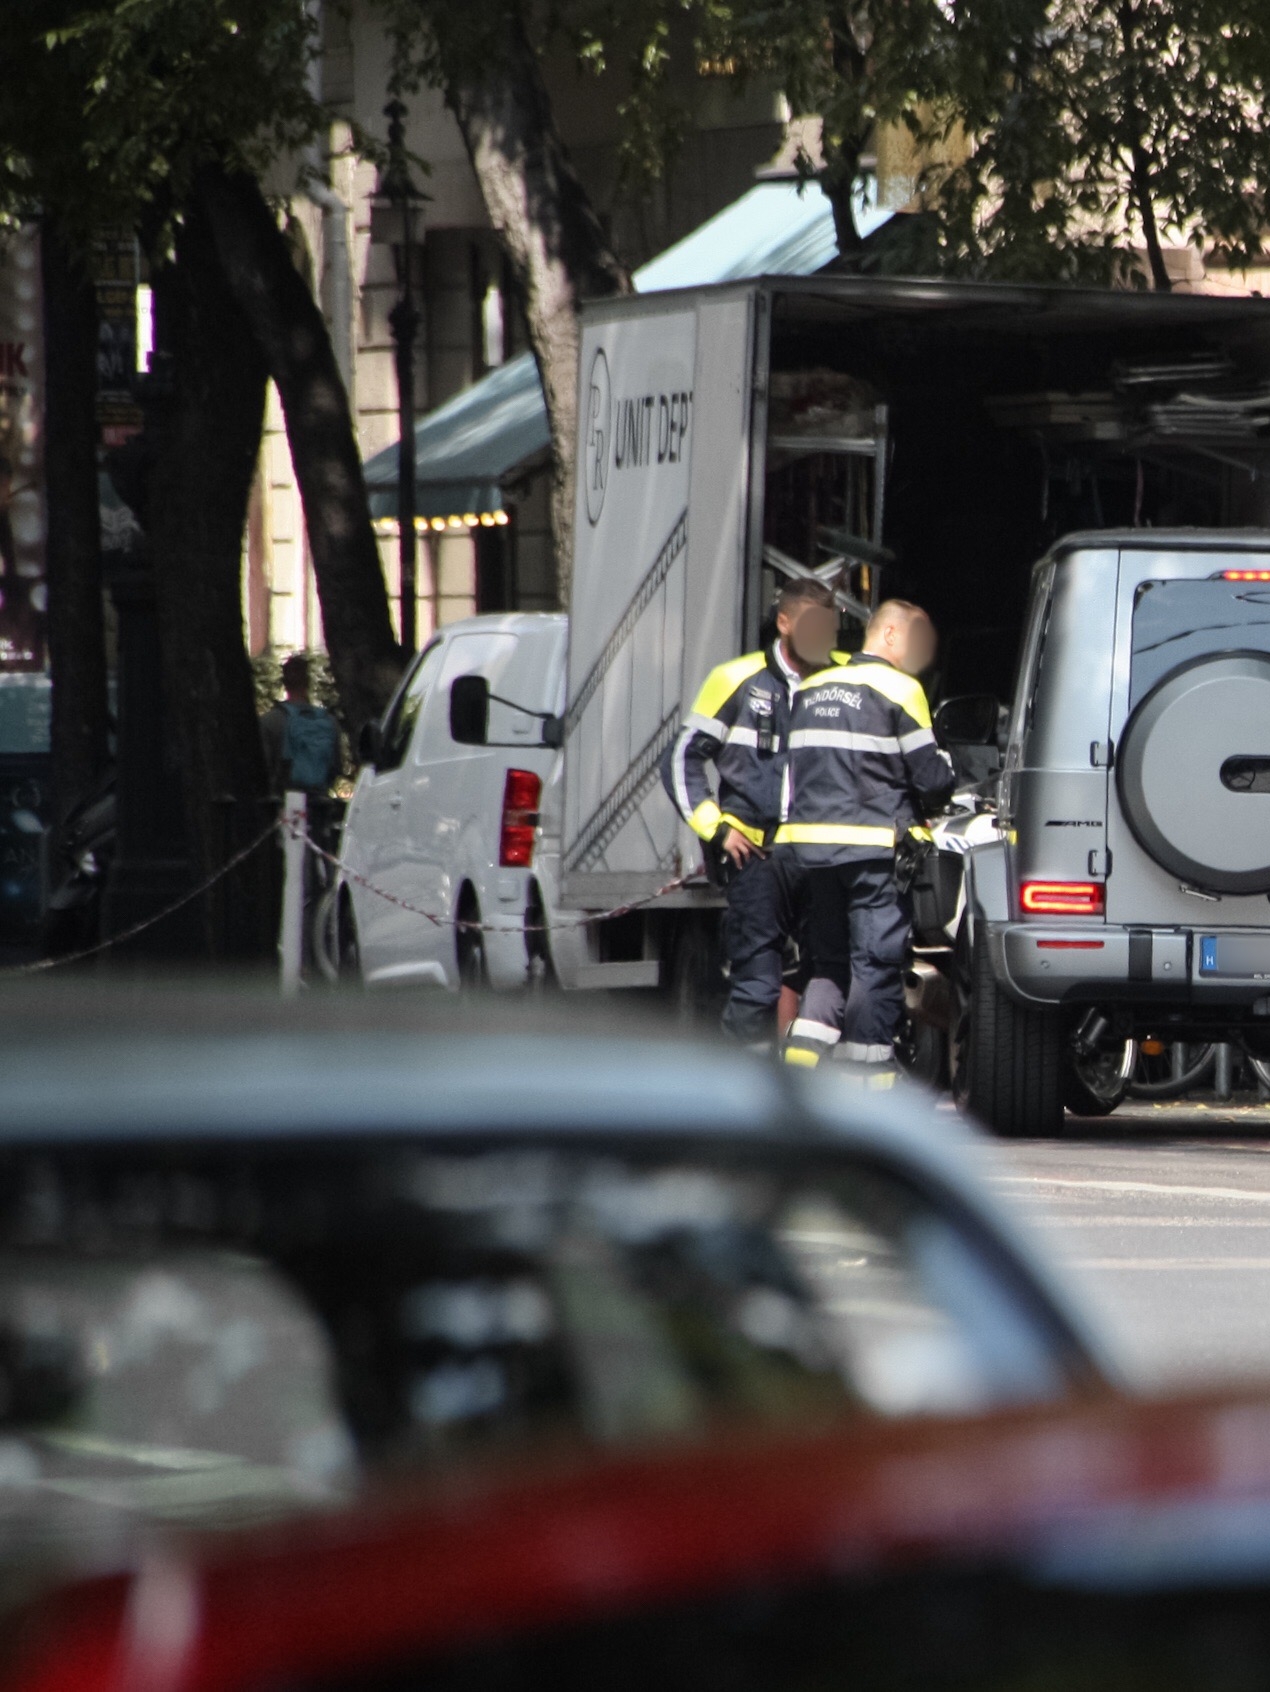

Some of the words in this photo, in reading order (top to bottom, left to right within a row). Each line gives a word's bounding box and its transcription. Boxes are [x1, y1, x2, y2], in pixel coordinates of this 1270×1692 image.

[615, 396, 655, 470] UNIT
[815, 707, 841, 717] POLICE
[1060, 820, 1104, 828] AMG
[1205, 955, 1214, 966] H
